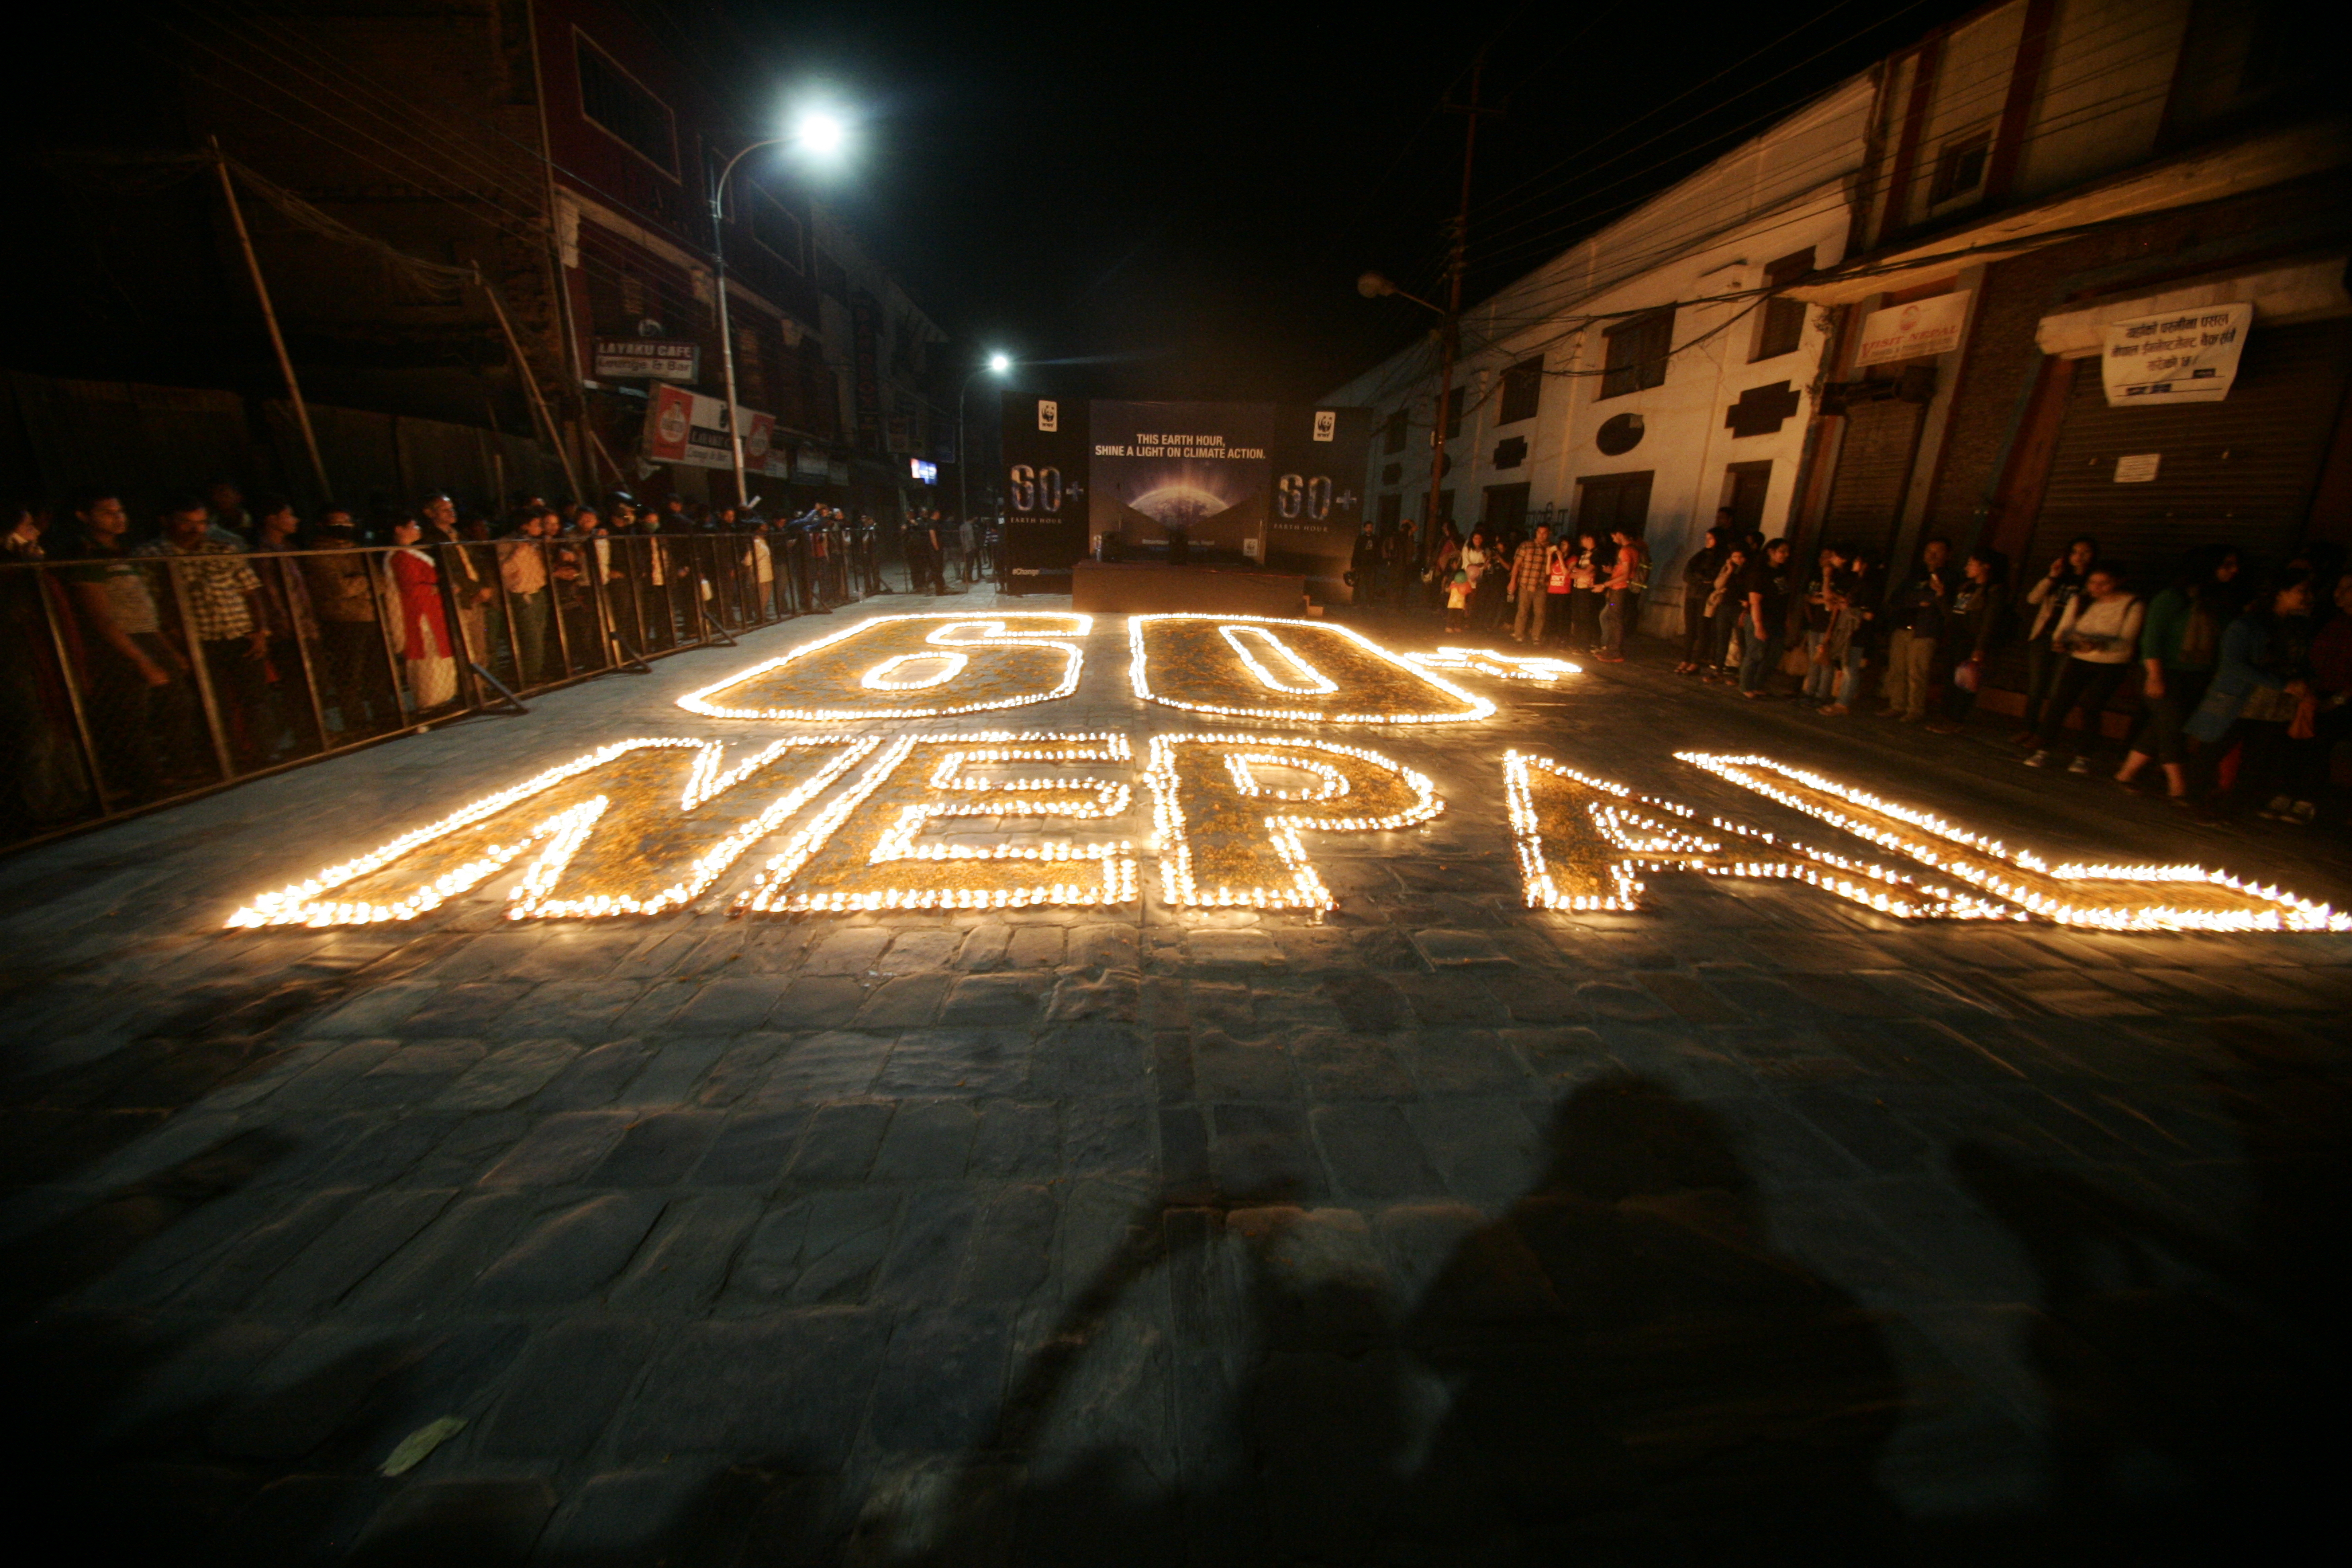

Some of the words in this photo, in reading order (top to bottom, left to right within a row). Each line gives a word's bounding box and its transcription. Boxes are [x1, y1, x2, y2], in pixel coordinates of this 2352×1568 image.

[656, 345, 691, 358] CAFE
[1095, 444, 1124, 456] SHINE
[1126, 446, 1134, 456] A
[1136, 446, 1165, 457] LIGHT
[1167, 446, 1181, 458] ON
[1183, 447, 1226, 459] CLIMATE
[1227, 448, 1266, 459] ACTION.
[1136, 434, 1159, 444] THIS
[1161, 434, 1193, 446] EARTH
[1195, 435, 1226, 448] HOUR,
[1011, 464, 1085, 512] 60+
[1278, 473, 1358, 520] 60+
[224, 730, 2352, 932] NEPAL
